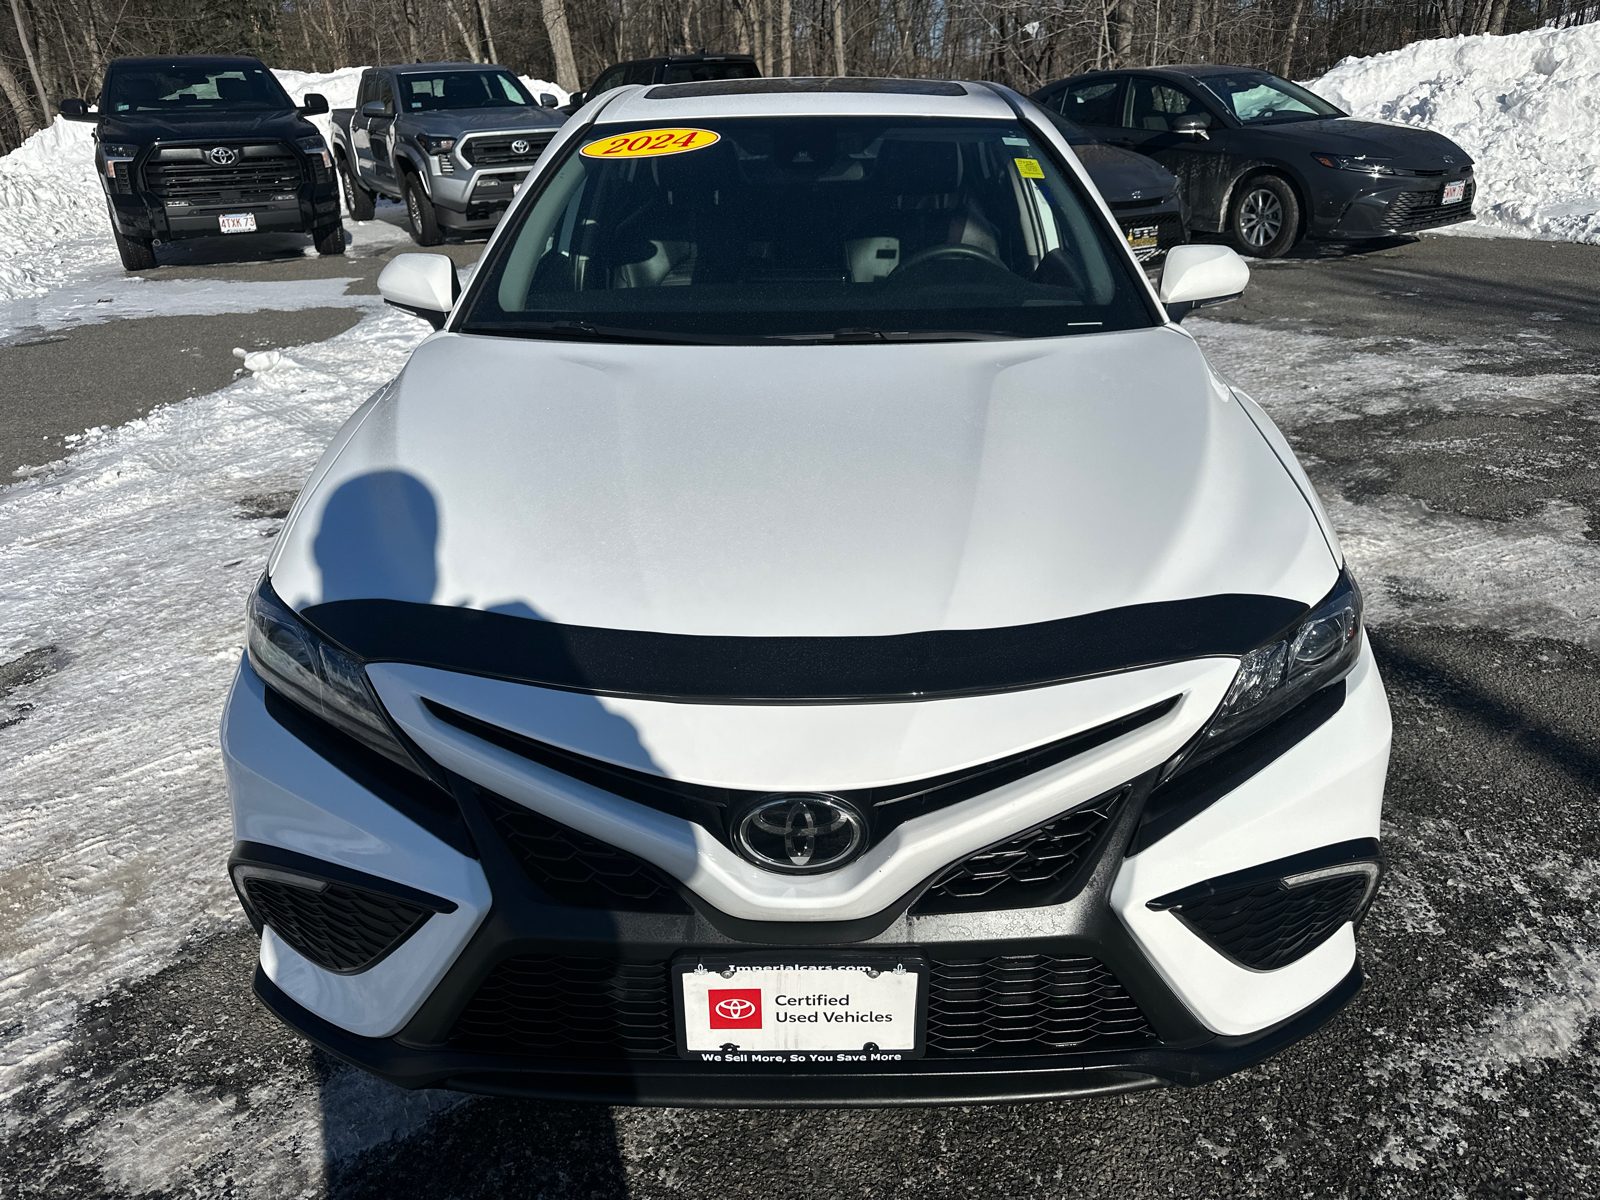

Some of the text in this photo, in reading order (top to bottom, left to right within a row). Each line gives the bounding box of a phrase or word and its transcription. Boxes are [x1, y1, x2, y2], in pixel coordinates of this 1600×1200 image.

[601, 131, 698, 155] 2024
[221, 217, 255, 228] 4TXK 73
[728, 963, 872, 972] Imperialcars.com
[774, 994, 850, 1006] Certified
[775, 1011, 893, 1023] Used Vehicles
[701, 1053, 902, 1064] We Sell More, So You Save More
